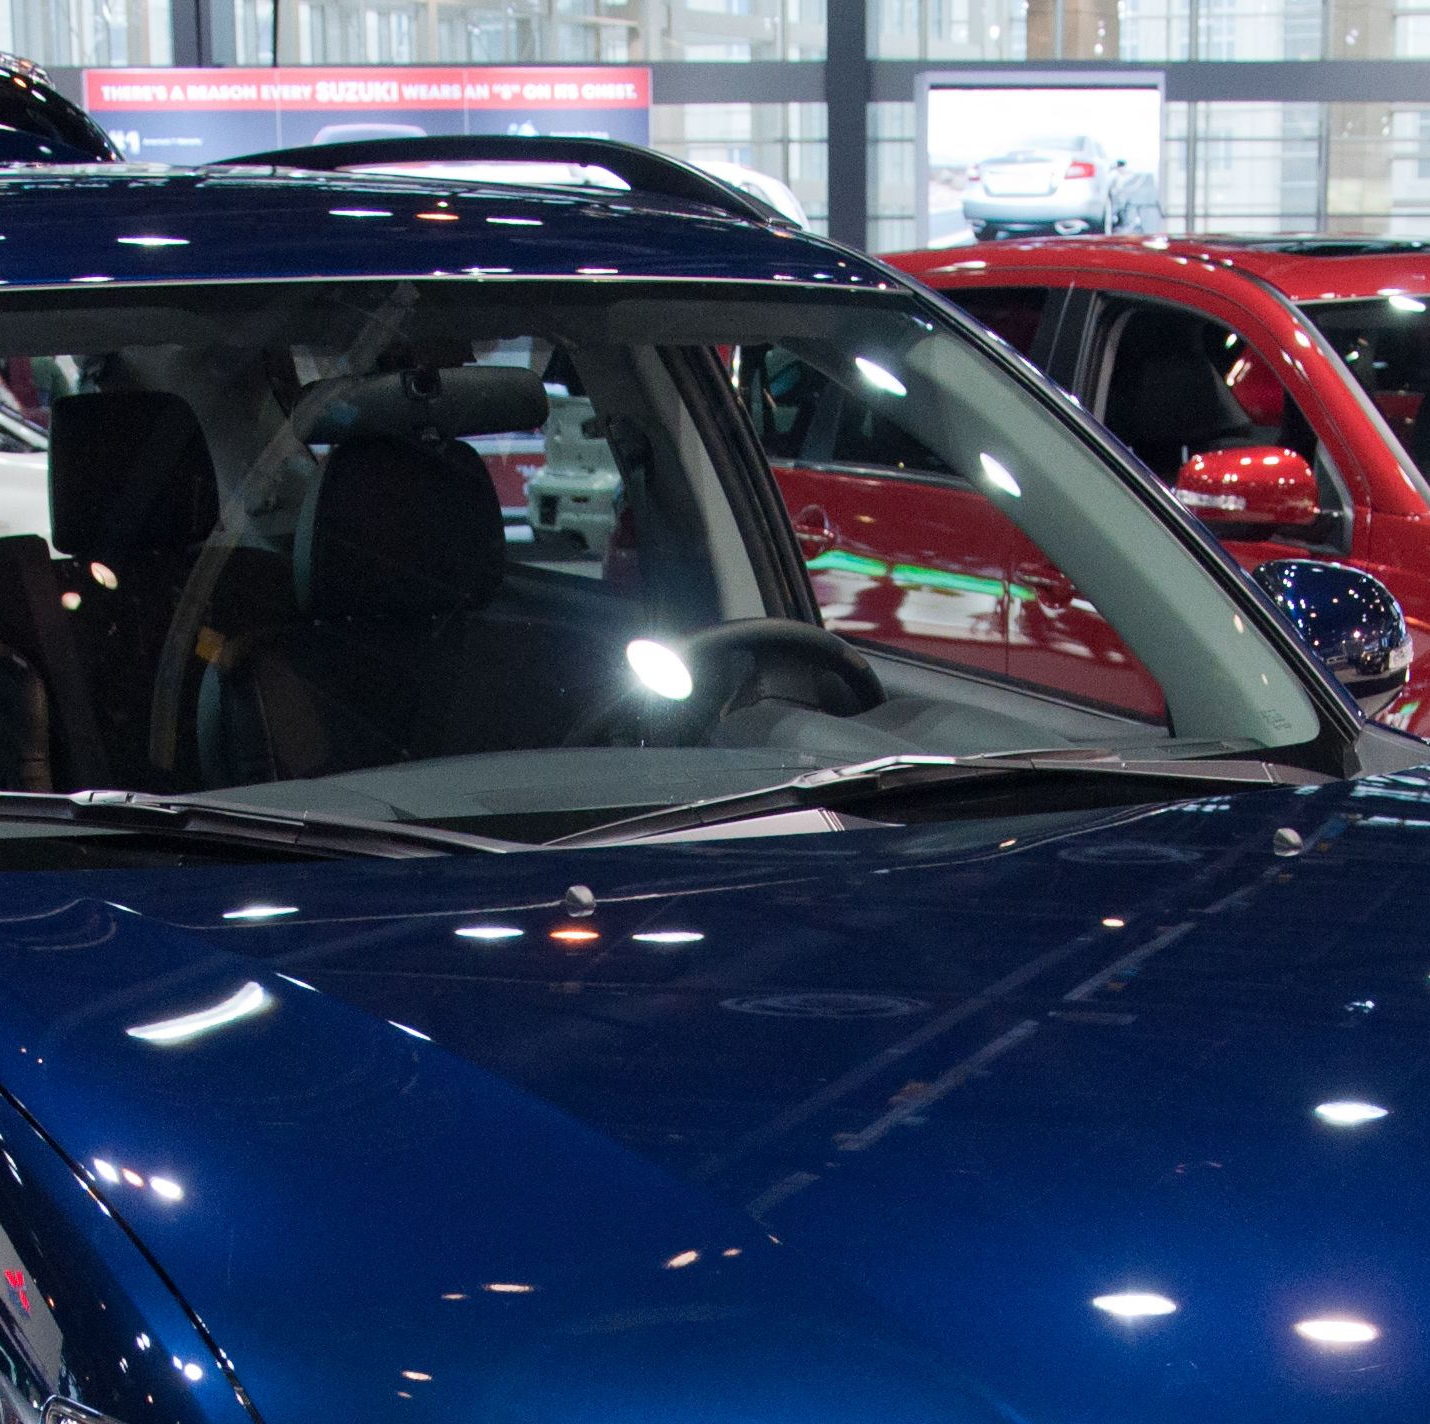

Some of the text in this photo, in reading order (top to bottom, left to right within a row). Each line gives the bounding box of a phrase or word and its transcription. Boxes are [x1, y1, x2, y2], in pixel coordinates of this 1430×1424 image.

[101, 84, 168, 101] THERE'S
[168, 84, 186, 100] A
[187, 84, 257, 100] REASON
[261, 83, 313, 100] EVERY
[315, 80, 399, 103] SUZUKI
[401, 83, 462, 99] WEARS
[464, 83, 490, 99] AN
[523, 83, 552, 99] ON
